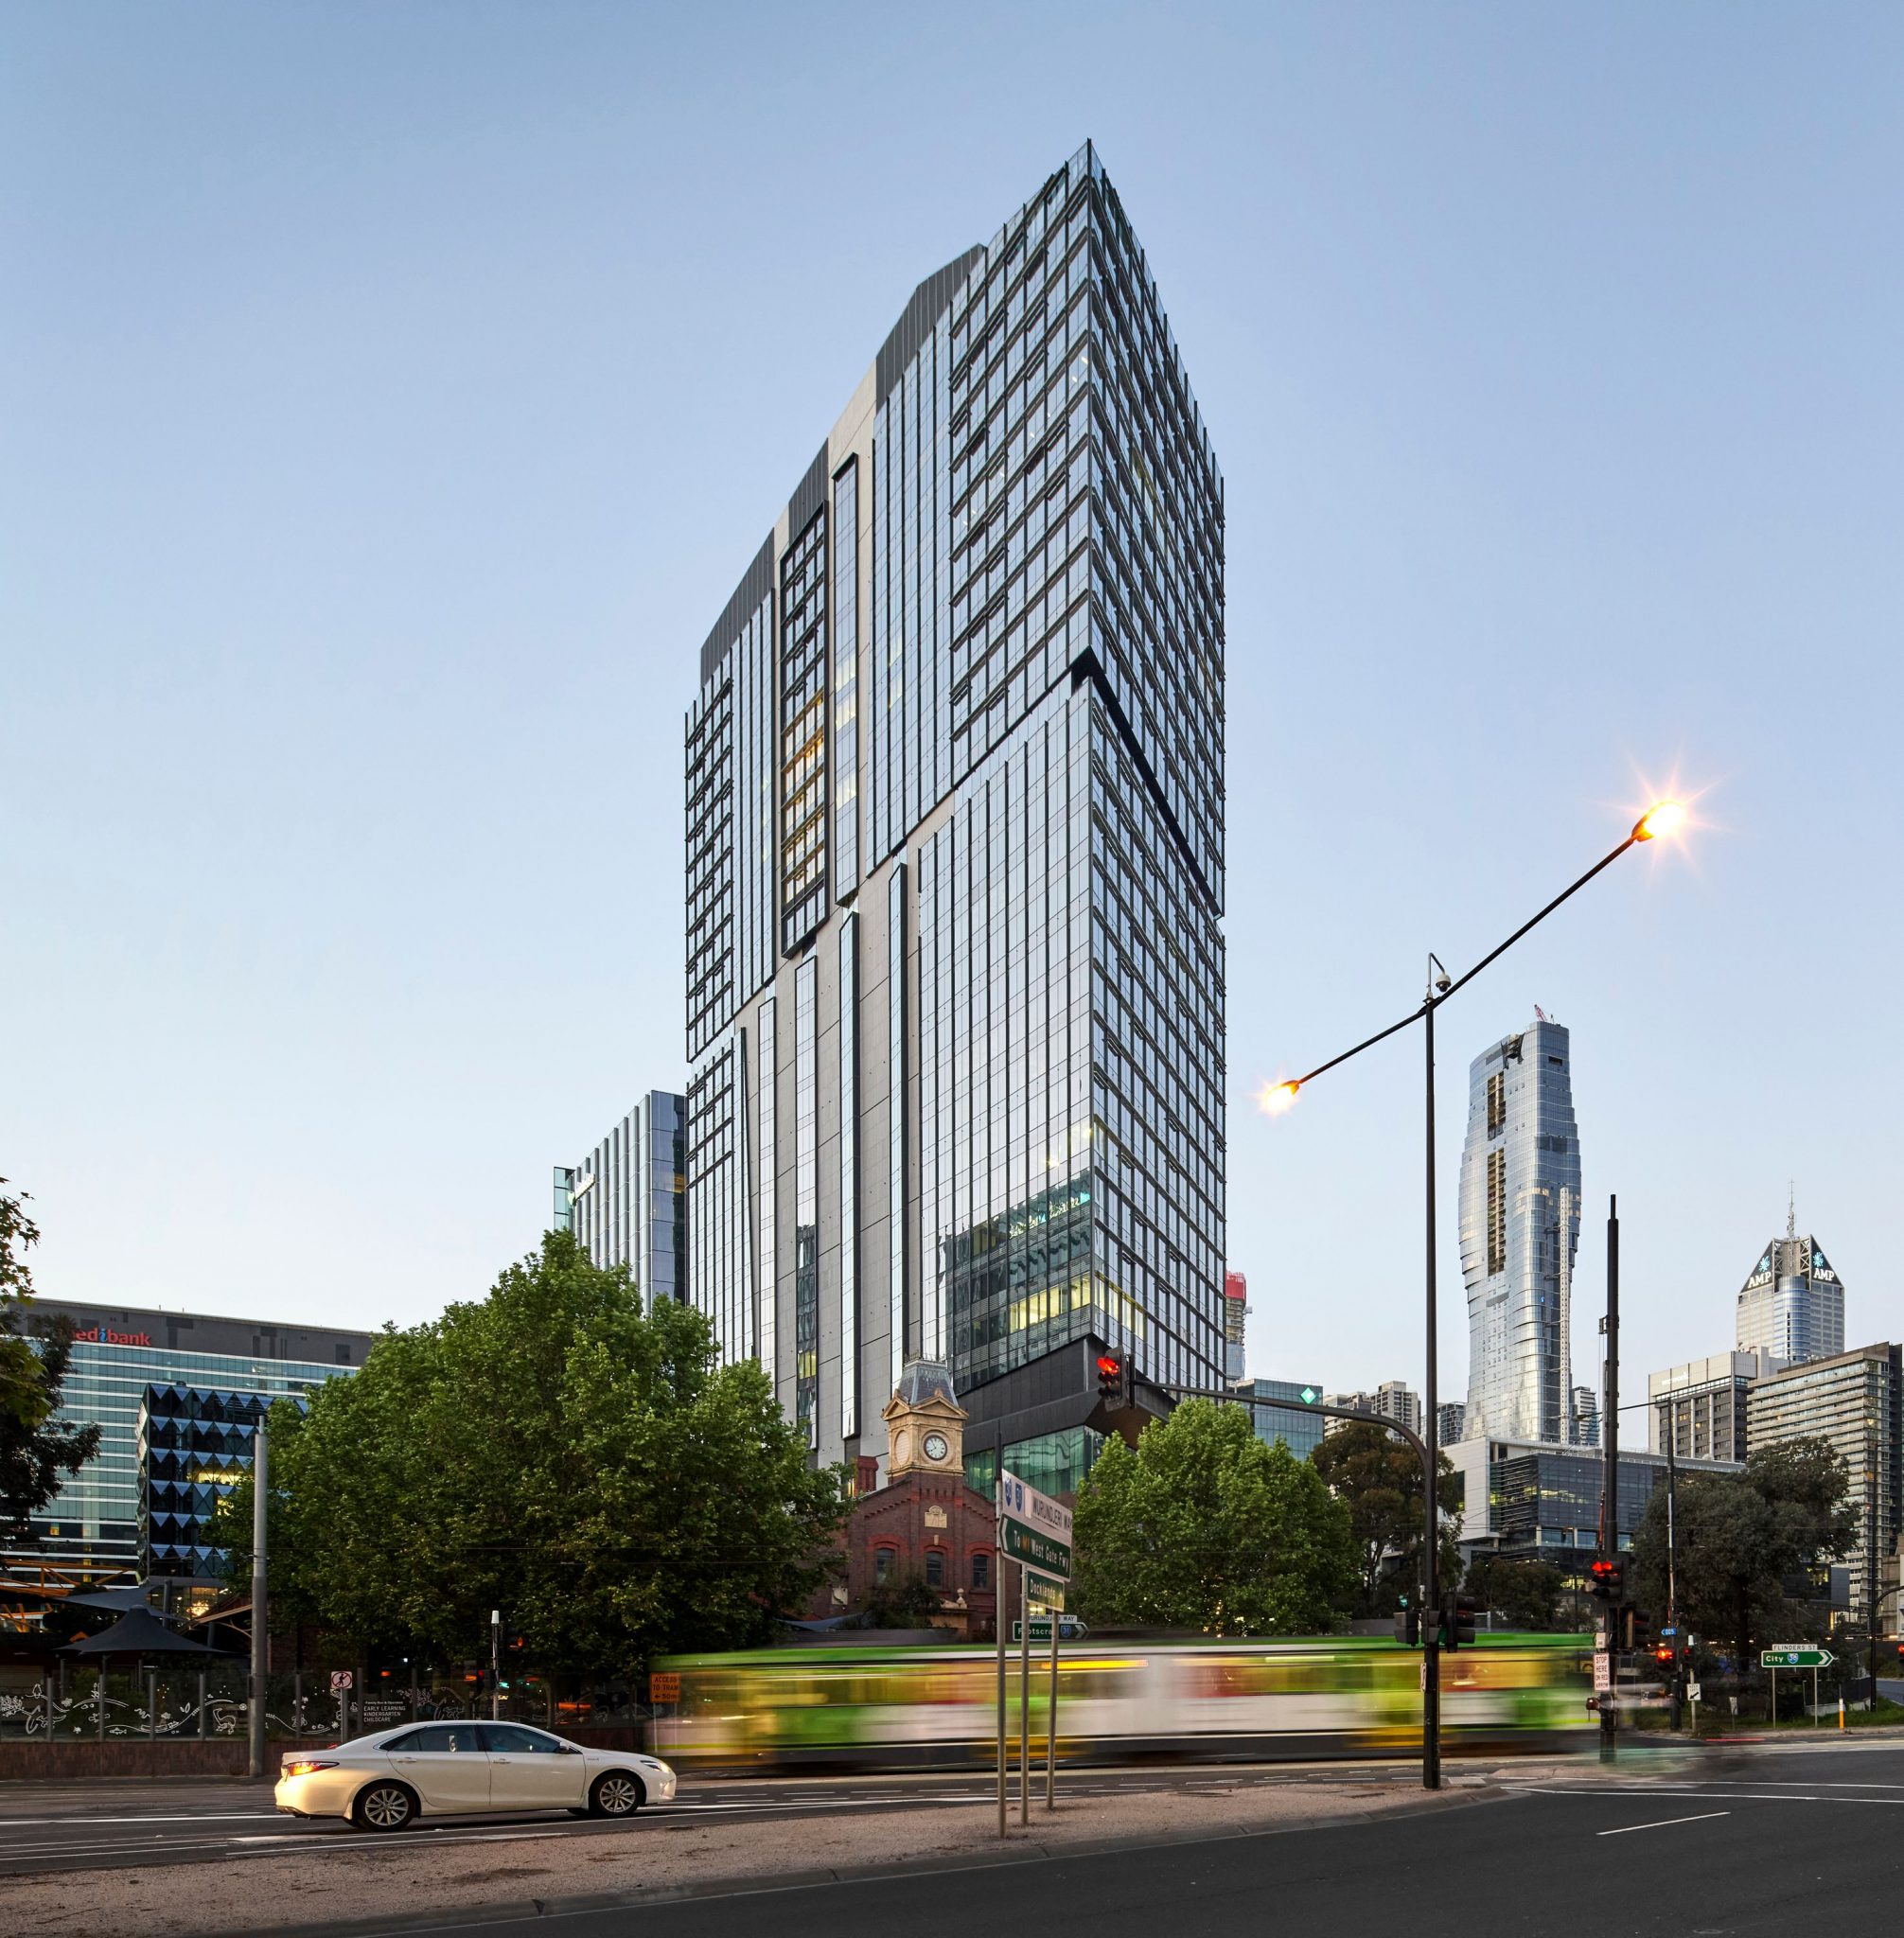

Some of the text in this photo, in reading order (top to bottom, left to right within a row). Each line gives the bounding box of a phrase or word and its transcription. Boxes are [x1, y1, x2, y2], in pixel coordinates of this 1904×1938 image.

[1748, 1271, 1772, 1289] AMP
[1813, 1268, 1834, 1281] AMP
[74, 1327, 151, 1347] edibank
[1014, 1529, 1021, 1548] To
[1031, 1538, 1044, 1559] West
[1046, 1544, 1058, 1564] Gate
[1030, 1578, 1056, 1600] Docklands
[1765, 1655, 1784, 1664] City
